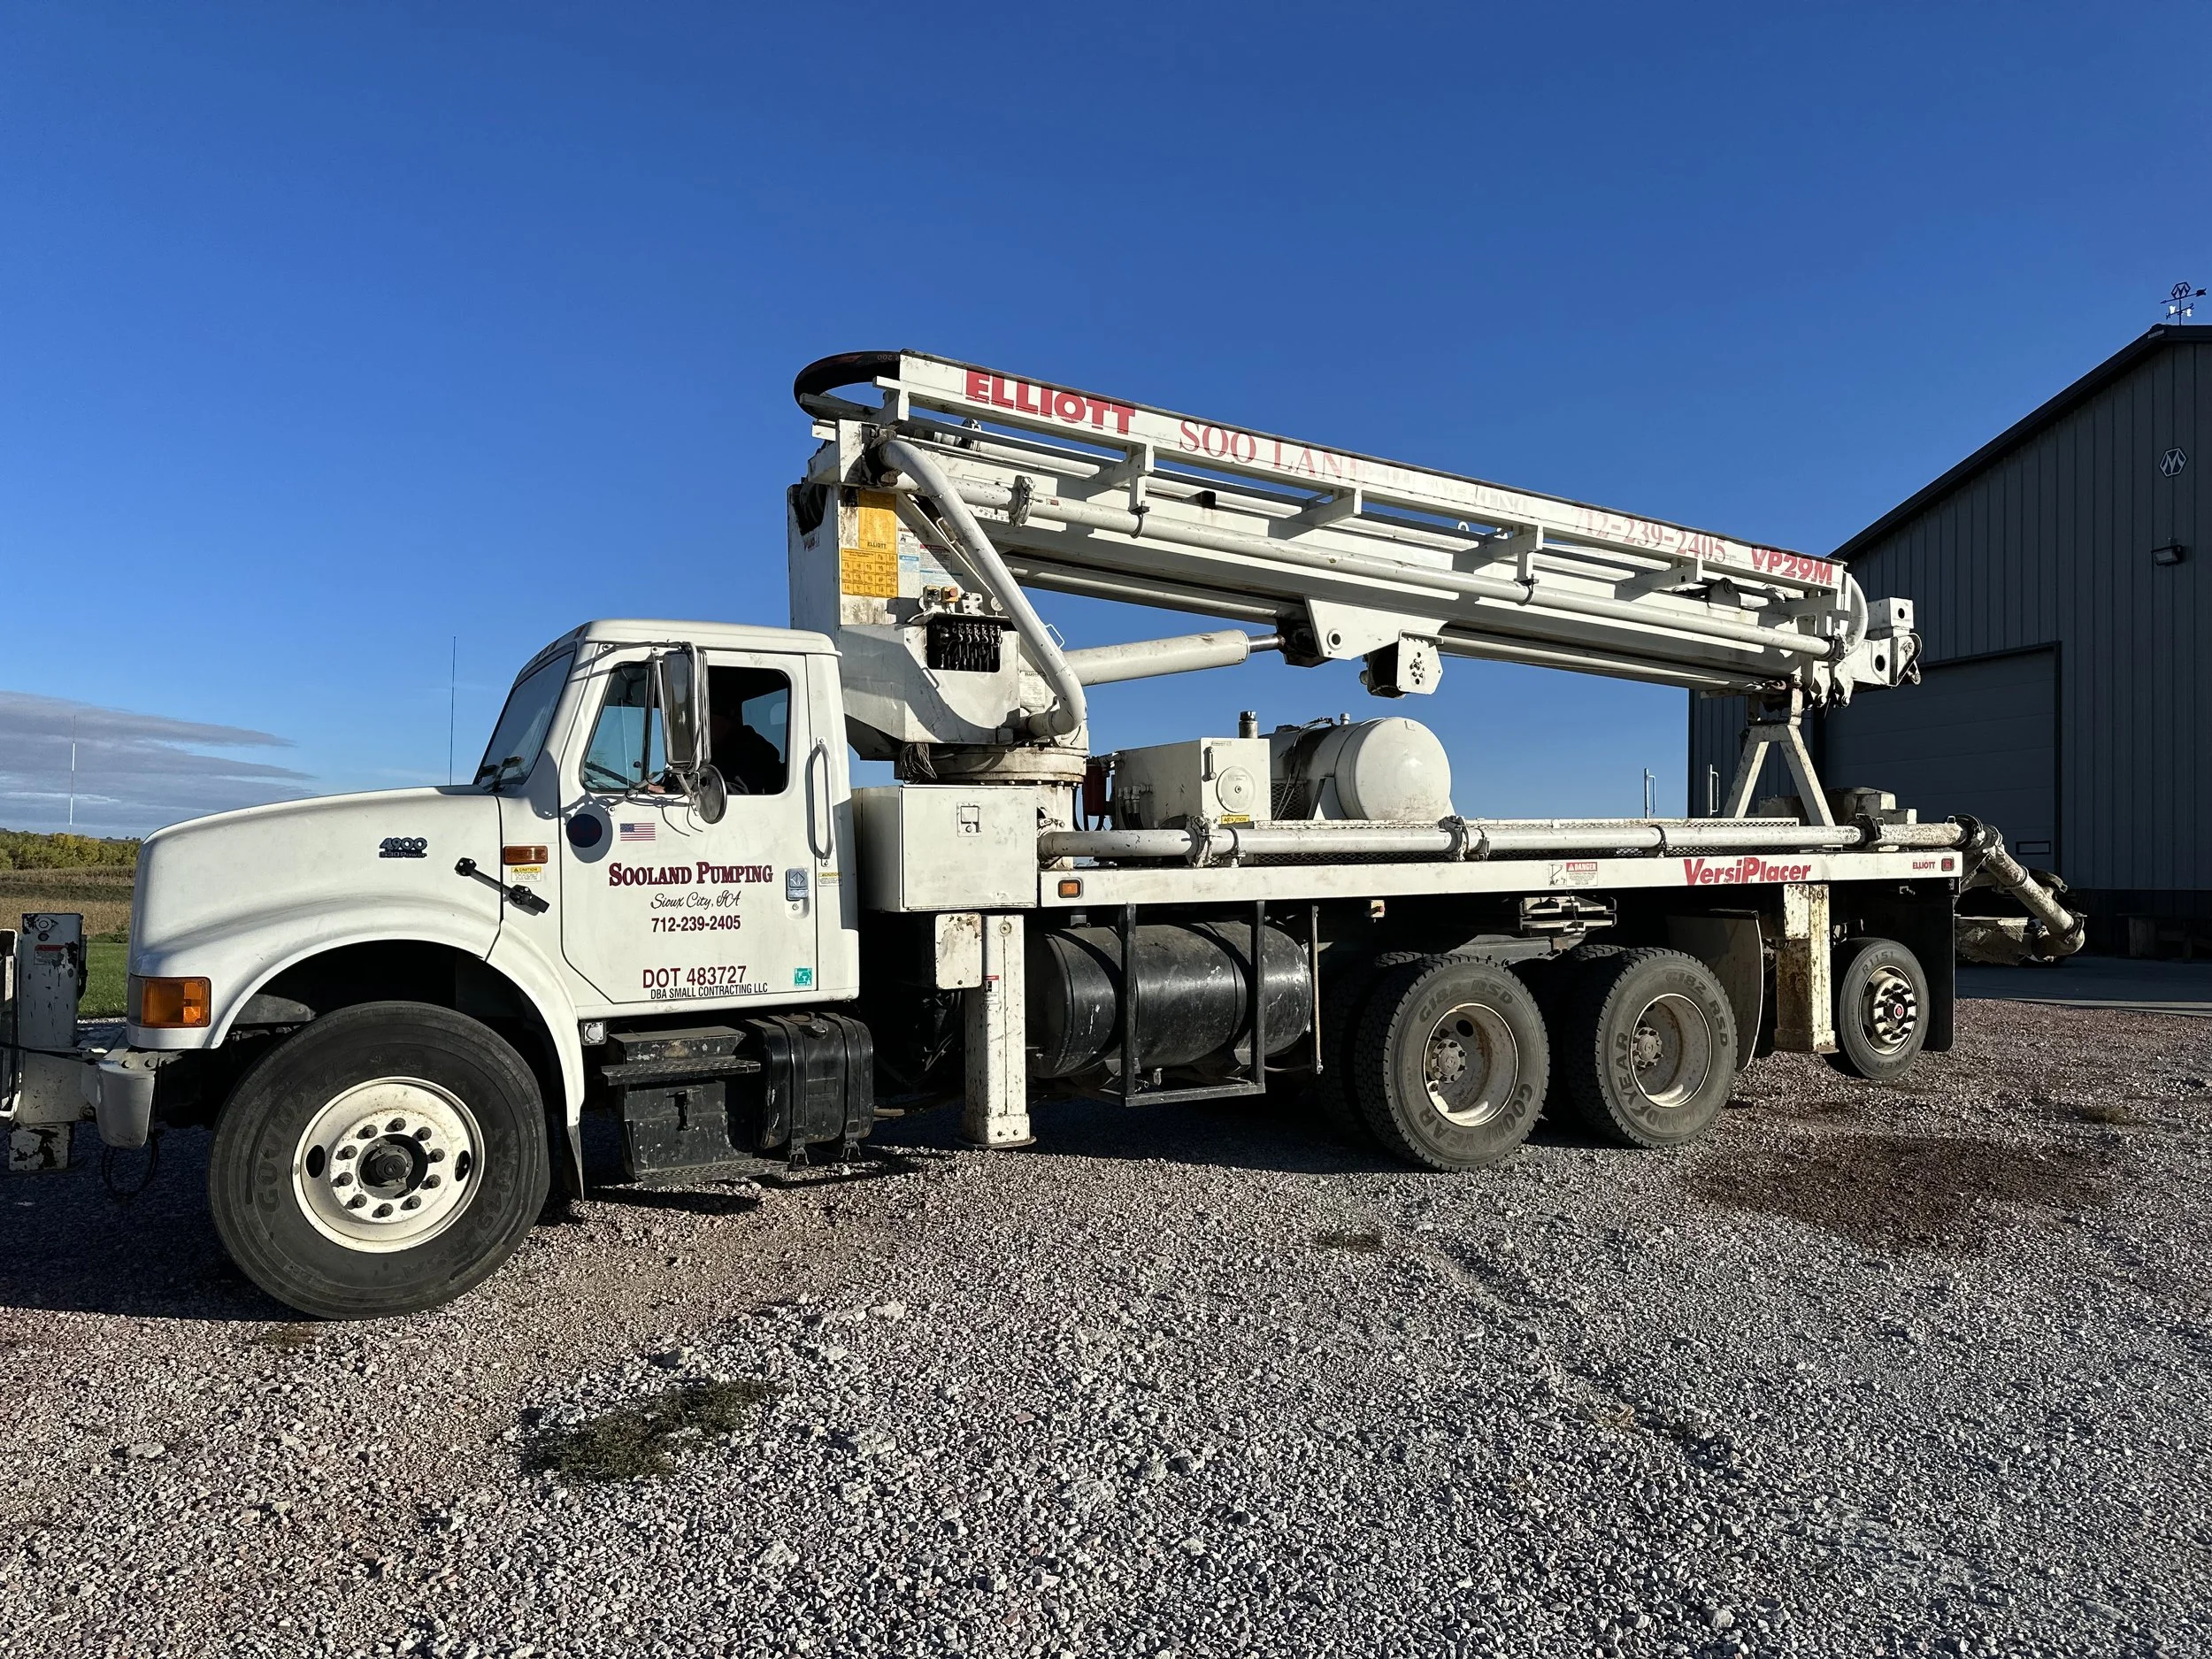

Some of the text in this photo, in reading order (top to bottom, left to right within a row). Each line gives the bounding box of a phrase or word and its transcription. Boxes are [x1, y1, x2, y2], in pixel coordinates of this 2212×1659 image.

[965, 368, 1135, 435] ELLIOTT
[1179, 419, 1256, 464] SOO
[867, 541, 887, 549] ELLIOTT
[1571, 508, 1727, 563] 712-239-2405
[1751, 547, 1832, 586] VP29M
[379, 837, 428, 850] 4900
[609, 862, 773, 886] SOOLAND PUMPING
[1575, 863, 1596, 872] DANGER
[1683, 856, 1812, 886] VersiPlacer
[1912, 861, 1936, 870] ELLIOTT
[650, 893, 684, 909] Sioux
[686, 891, 713, 910] City,
[651, 915, 741, 933] 712-239-2405
[642, 965, 747, 988] DOT 483727
[650, 982, 768, 1000] DBA SMALL CONTRACTING LLC
[1471, 979, 1514, 1005] RSD
[1708, 1000, 1728, 1048] RSD
